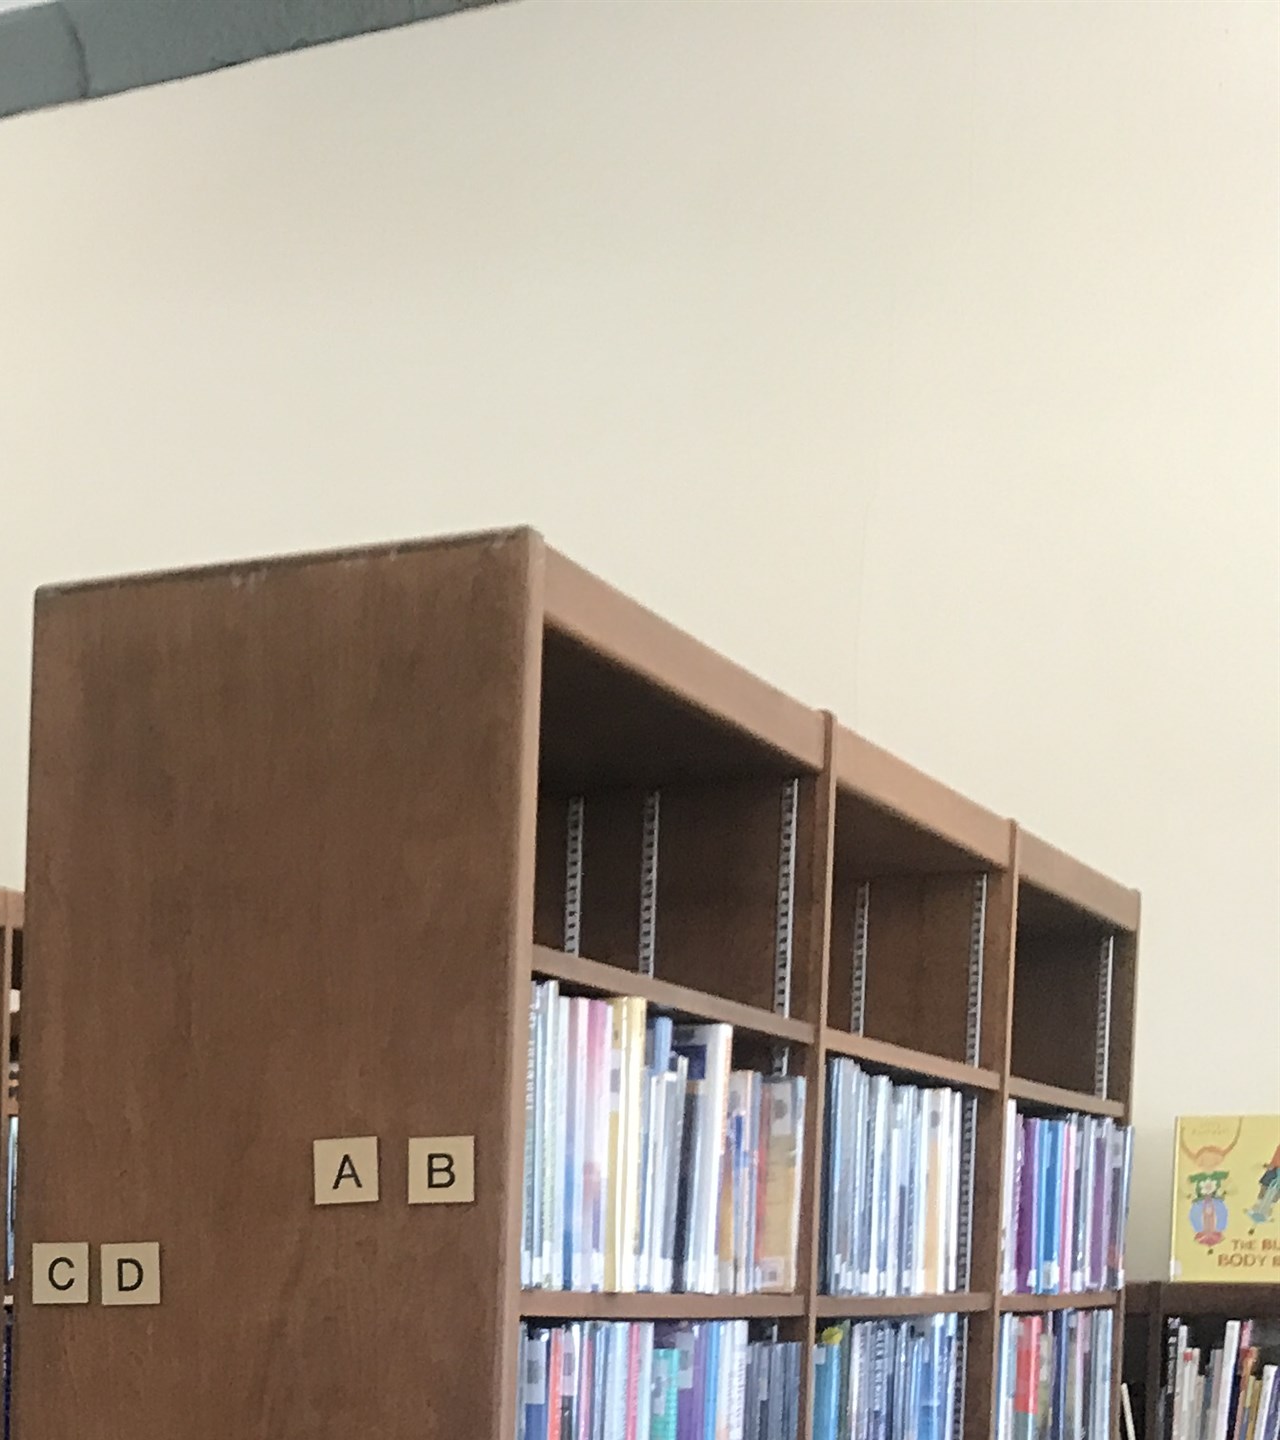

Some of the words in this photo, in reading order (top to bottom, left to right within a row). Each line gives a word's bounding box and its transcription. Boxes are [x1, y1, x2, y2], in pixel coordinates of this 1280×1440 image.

[333, 1154, 362, 1190] A
[427, 1153, 455, 1189] B
[1231, 1238, 1255, 1250] THE
[1217, 1253, 1267, 1267] BODY
[48, 1257, 75, 1291] C
[117, 1258, 143, 1292] D
